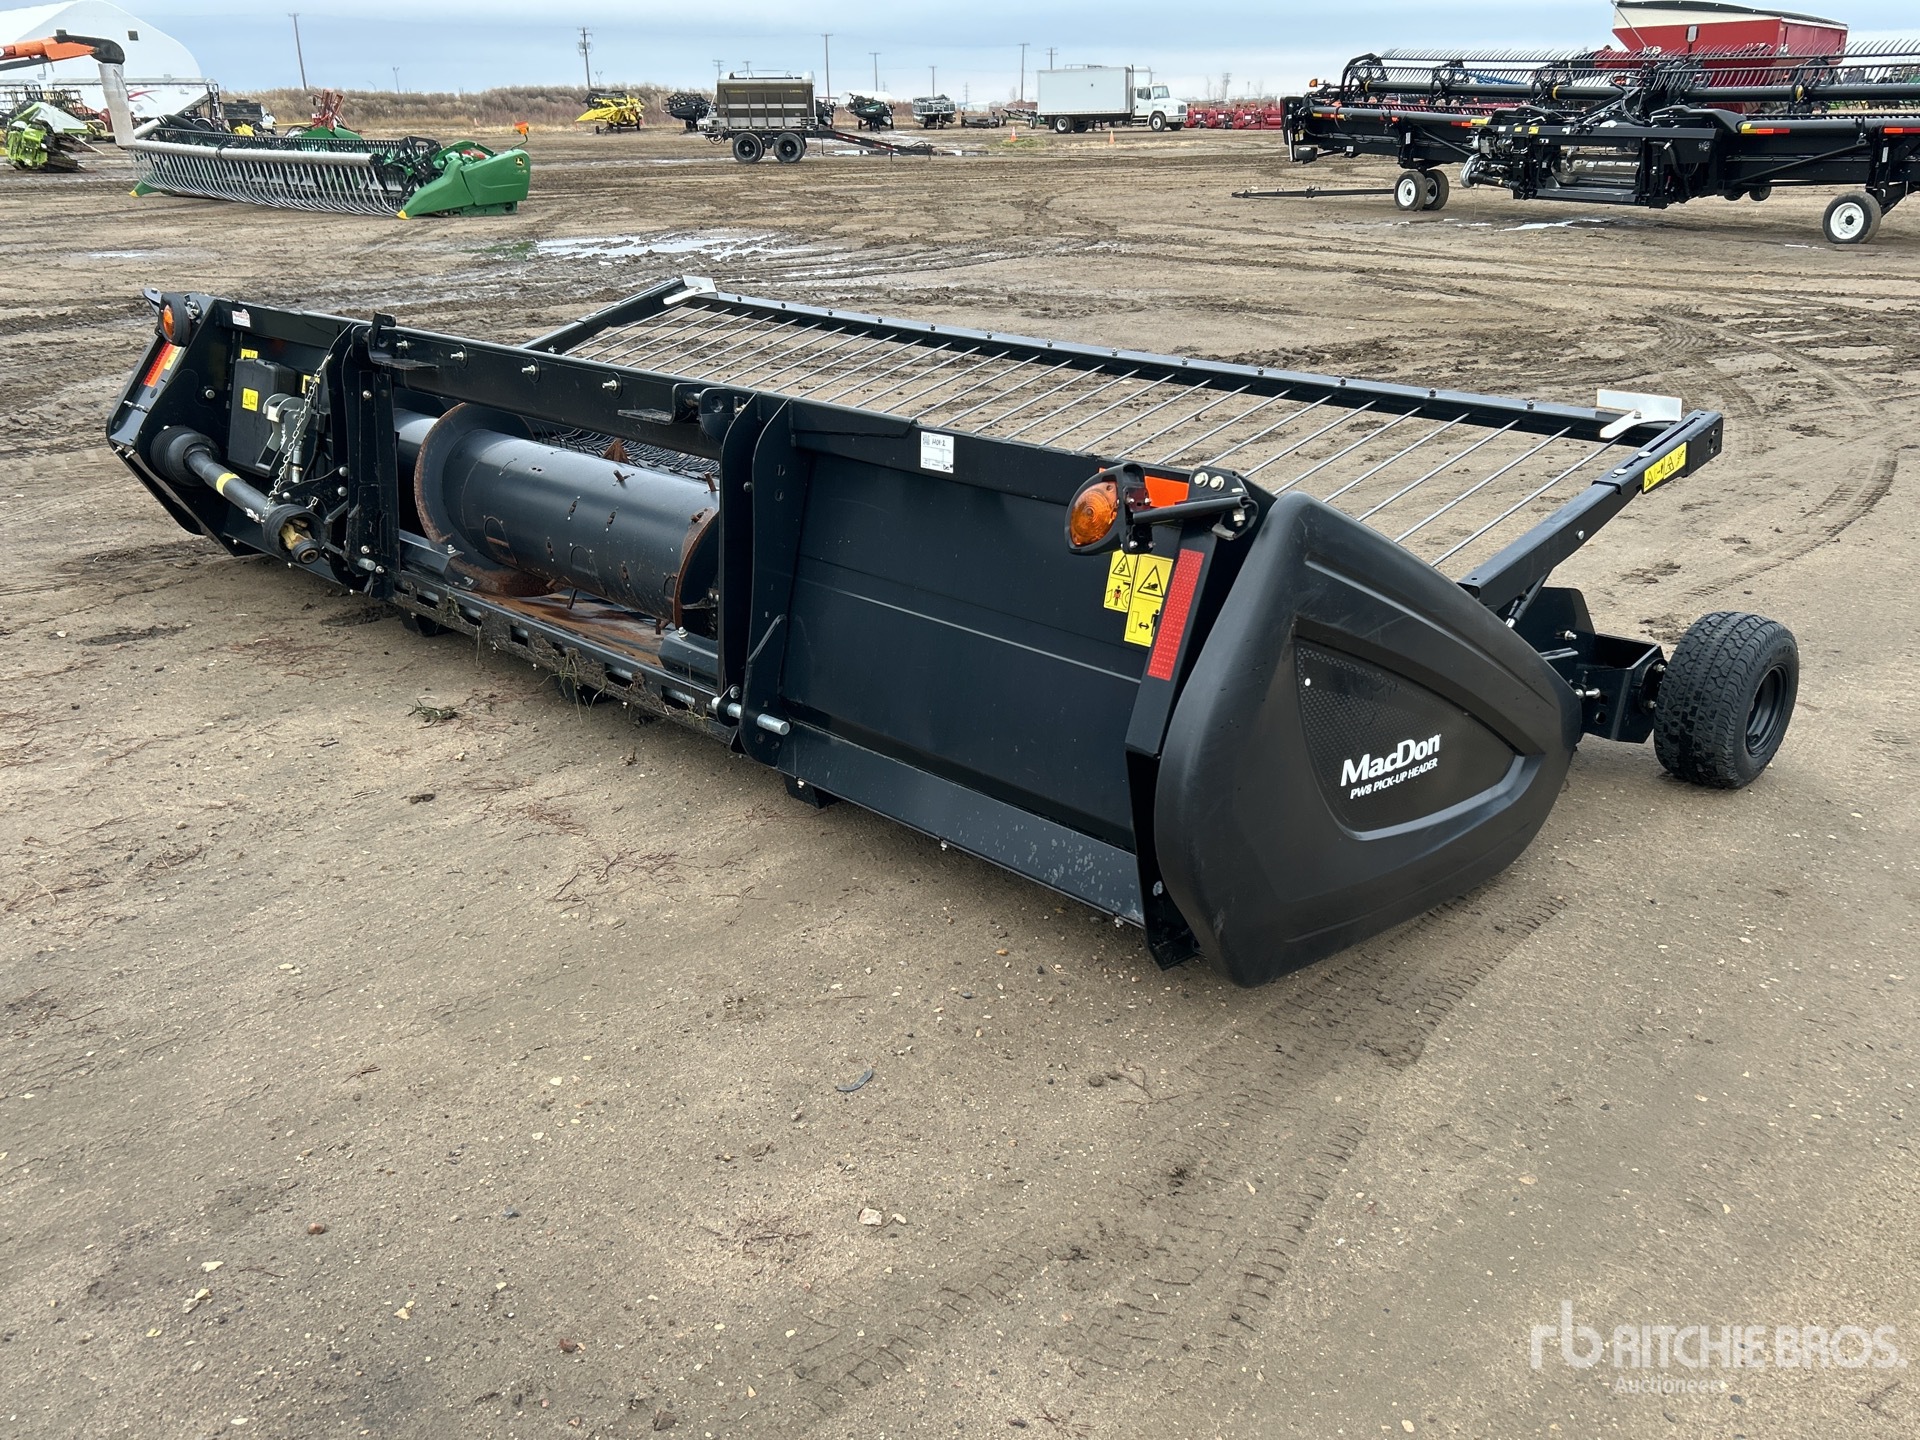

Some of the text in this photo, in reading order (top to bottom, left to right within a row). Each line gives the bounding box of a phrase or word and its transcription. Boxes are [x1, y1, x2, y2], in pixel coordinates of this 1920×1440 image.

[1340, 734, 1441, 787] MacDon
[1350, 758, 1438, 799] PW8 PICK-UP HEADER
